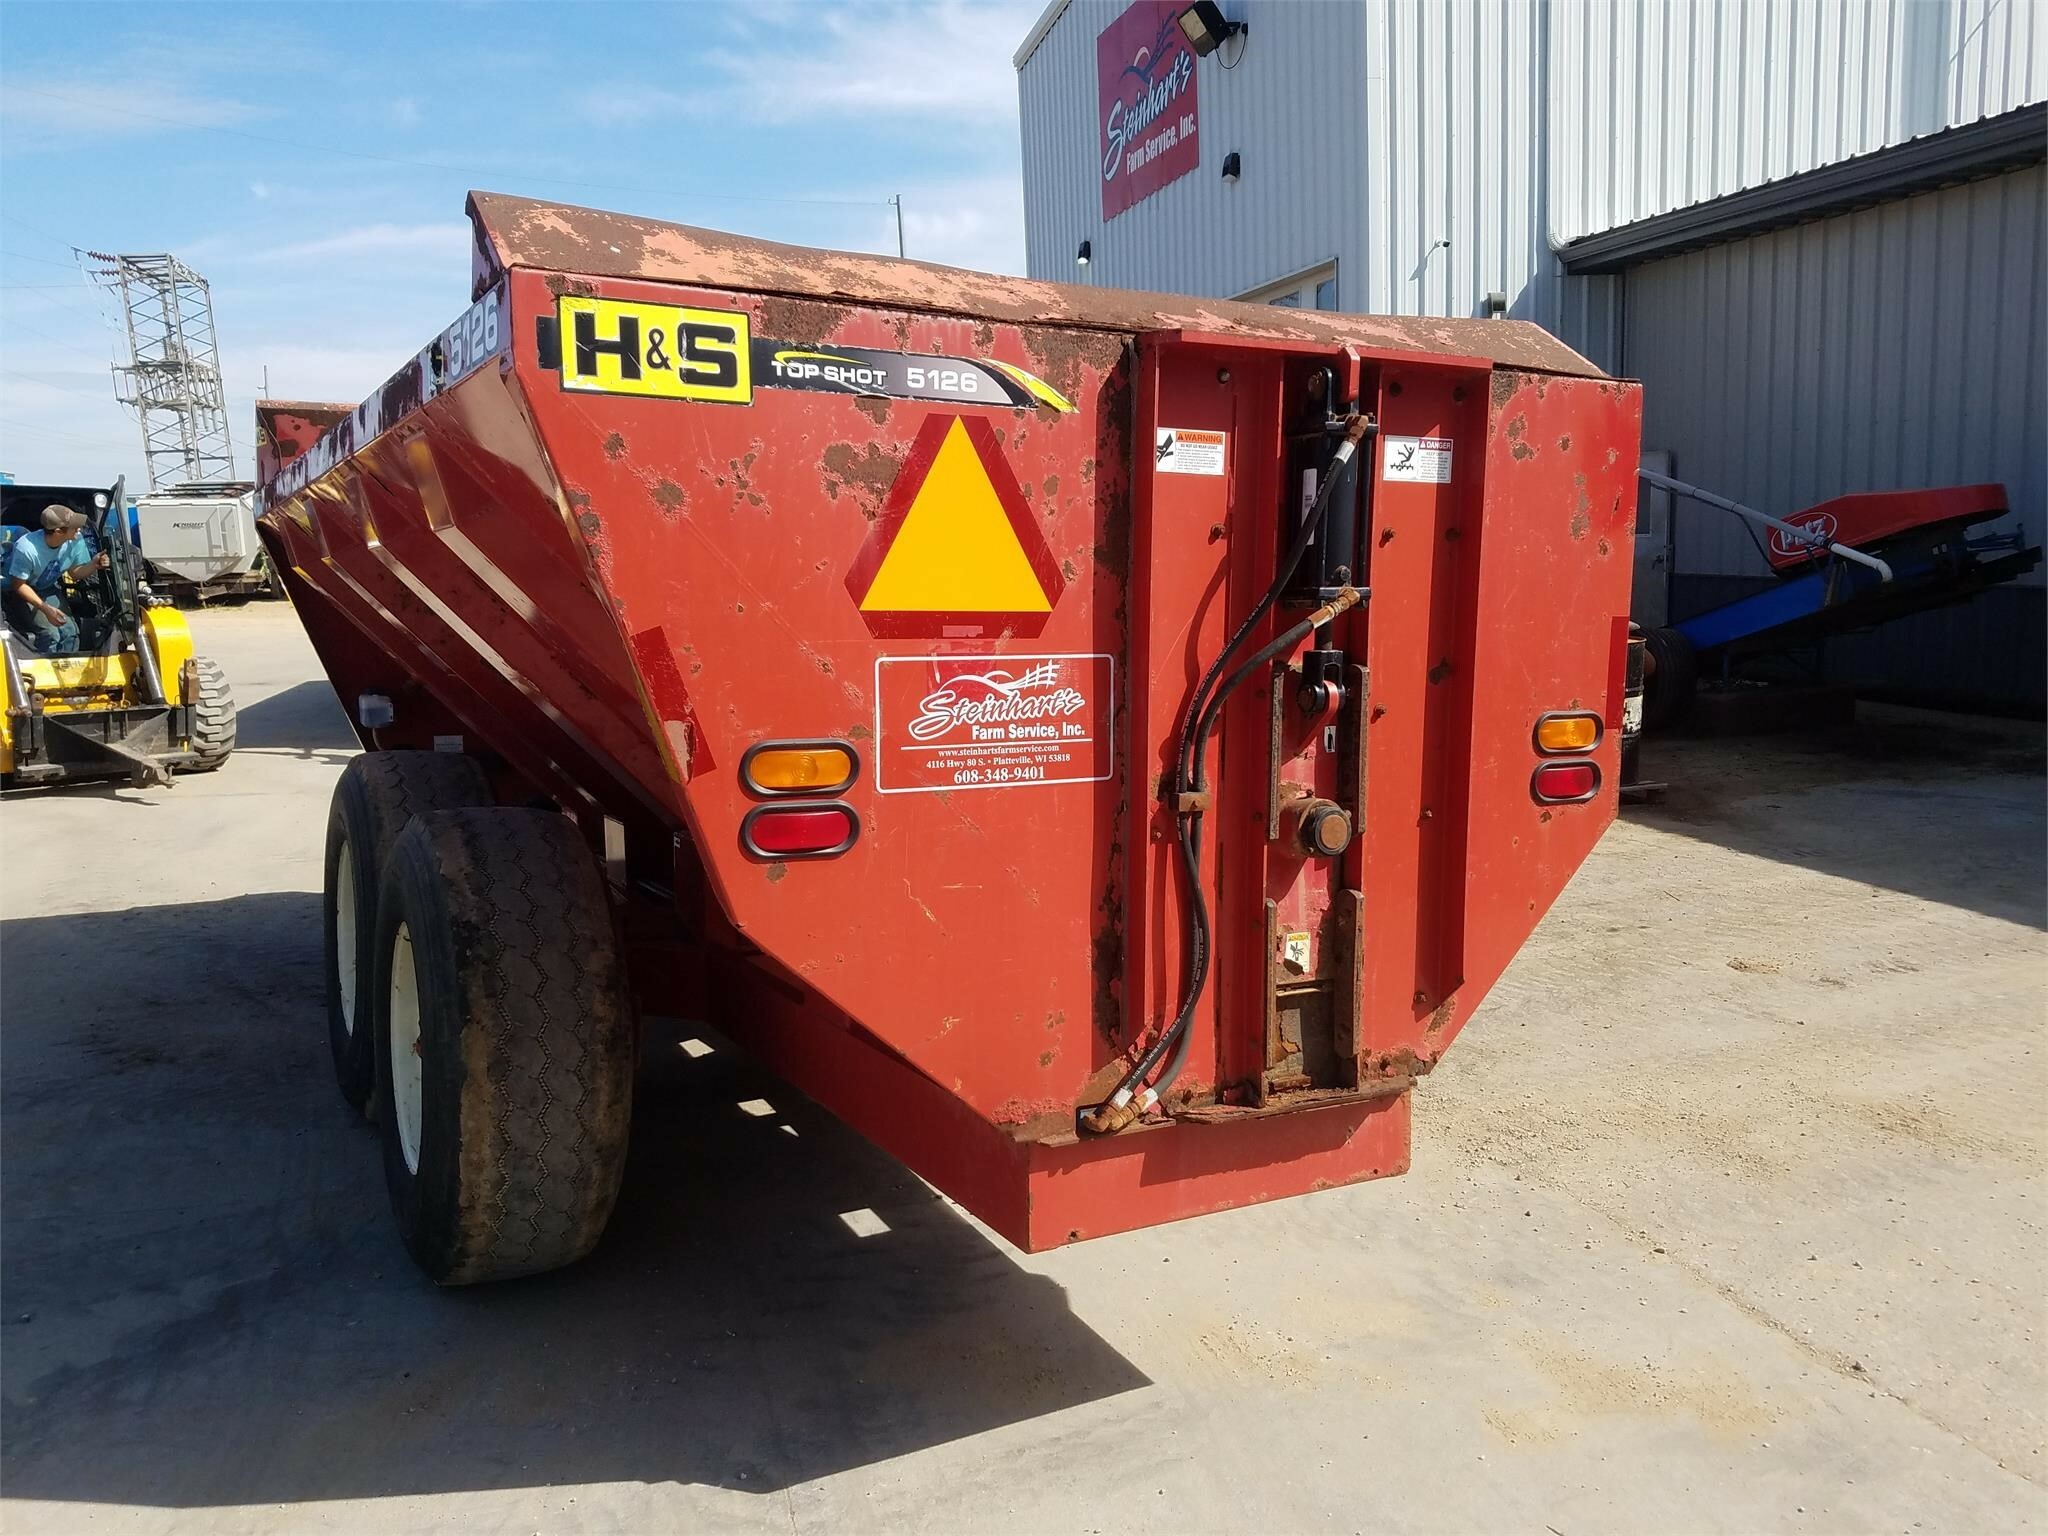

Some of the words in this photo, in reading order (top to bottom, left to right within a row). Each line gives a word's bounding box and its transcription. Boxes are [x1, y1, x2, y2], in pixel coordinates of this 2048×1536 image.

[1104, 50, 1193, 181] Steinhart's
[1126, 147, 1145, 175] Farm
[1145, 125, 1178, 162] Service,
[1179, 112, 1196, 140] Inc.
[449, 290, 499, 377] 5126
[574, 312, 738, 387] H&S
[771, 360, 820, 378] TOP
[823, 366, 887, 388] SHOT
[906, 366, 979, 393] 5126
[1184, 433, 1222, 443] WARNING
[1426, 441, 1451, 450] DANGER
[908, 688, 1085, 740] Steinhart's
[971, 724, 1005, 740] Farm
[1008, 723, 1059, 740] Service,
[1062, 721, 1086, 736] Inc.
[926, 760, 945, 769] 4116
[946, 759, 965, 769] Hwy
[966, 758, 977, 767] 80
[978, 757, 987, 766] S.
[993, 756, 1034, 766] Platteville,
[1035, 755, 1048, 764] WI
[1048, 753, 1071, 763] 53818
[938, 744, 1060, 757] www.steinhartsfarmservice.com
[953, 766, 1045, 784] 608-348-9401
